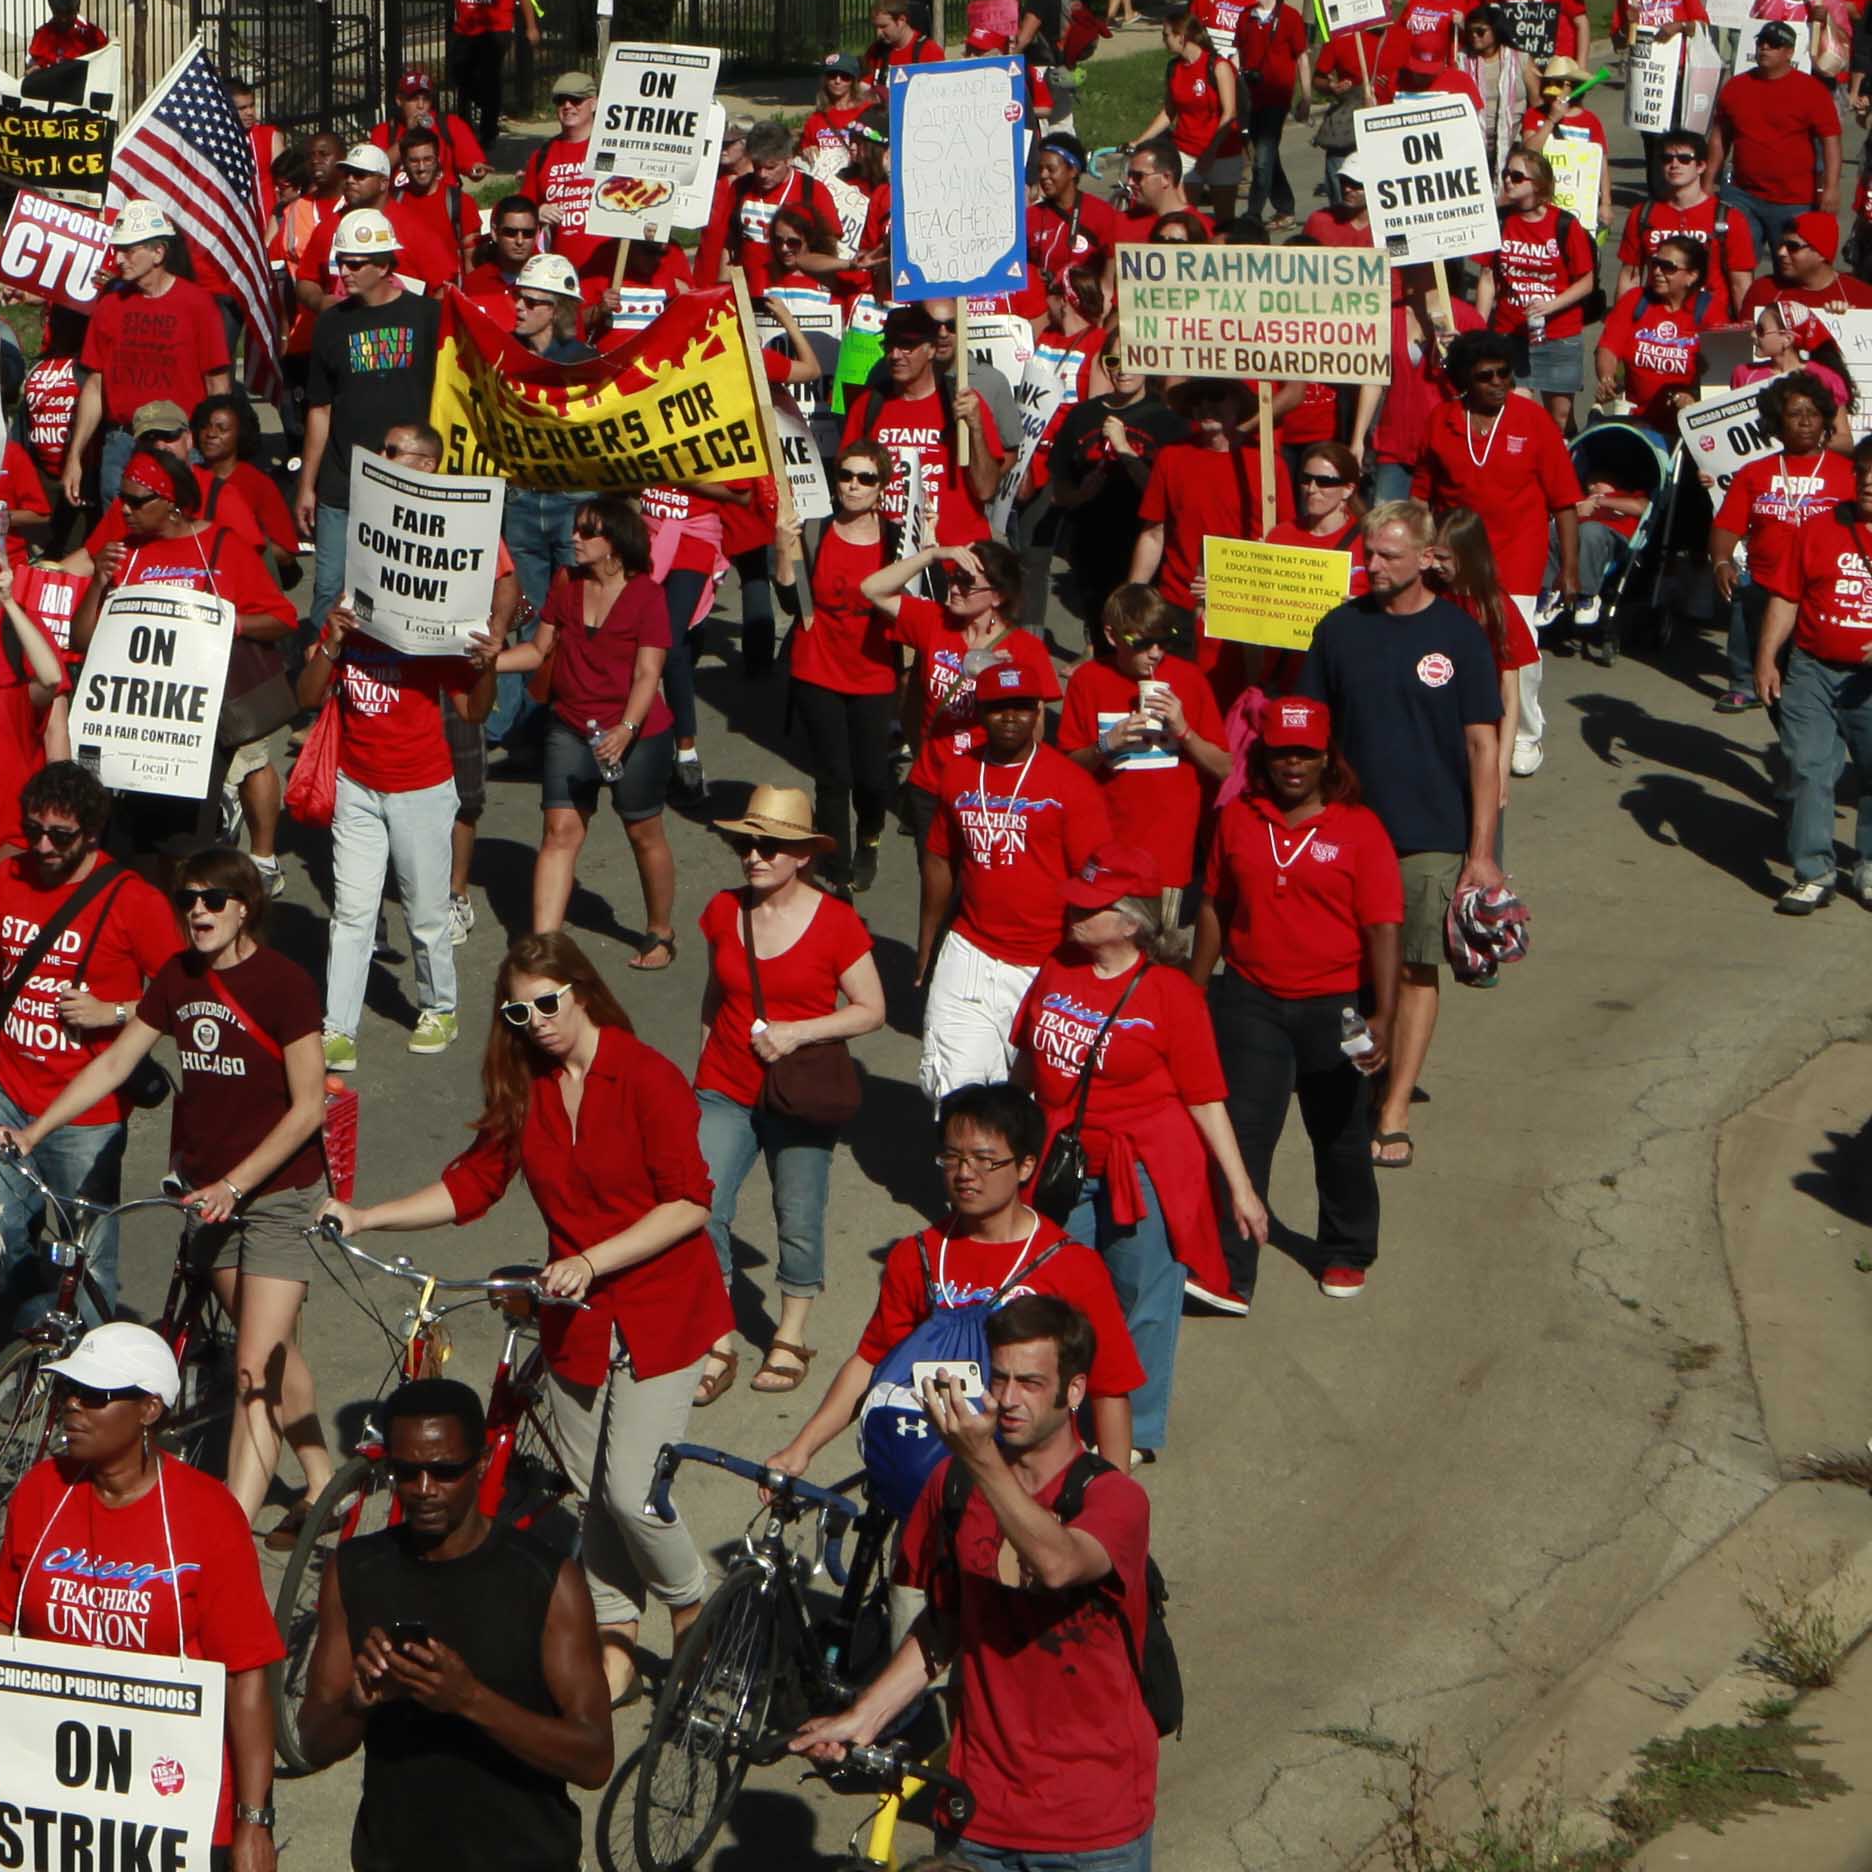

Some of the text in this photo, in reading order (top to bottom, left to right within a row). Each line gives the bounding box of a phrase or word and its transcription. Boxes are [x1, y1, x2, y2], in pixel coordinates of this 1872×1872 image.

[639, 71, 676, 98] ON
[1643, 87, 1663, 99] are
[605, 105, 697, 136] STRIKE
[1645, 100, 1662, 112] for
[601, 138, 693, 155] FOR BETTER SCHOOLS
[913, 123, 996, 162] SAY
[1402, 132, 1443, 165] ON
[1377, 166, 1481, 211] STRIKE
[19, 200, 114, 241] SUPPORTS
[1384, 216, 1403, 228] FOR
[1413, 211, 1432, 224] FAIR
[1434, 204, 1485, 222] CONTRACT
[1, 222, 106, 302] CTU
[1120, 251, 1385, 286] NO RAHMUNISM
[1133, 288, 1380, 315] KEEP TAX DOLLARS
[1134, 315, 1378, 346] IN THE CLASSROOM
[1127, 345, 1391, 377] NOT THE BOARDROOM
[1634, 352, 1686, 375] UNION
[1638, 342, 1688, 359] TEACHERS
[659, 383, 716, 435] FOR
[392, 505, 445, 538] FAIR
[358, 522, 483, 572] CONTRACT
[1231, 550, 1328, 568] YOU THINK THAT PUBLIC
[380, 566, 448, 603] NOW!
[1210, 574, 1248, 585] COUNTRY
[1259, 580, 1274, 588] NOT
[1277, 583, 1306, 592] UNDER
[1309, 588, 1340, 596] ATTACK
[1226, 563, 1324, 581] EDUCATION ACROSS THE
[111, 599, 173, 615] CHICAGO PUBLIC
[1211, 603, 1266, 616] HOODWINKED
[1268, 611, 1285, 620] AND
[1252, 595, 1331, 611] BEEN BAMBOOZLED
[404, 620, 447, 637] Local
[128, 627, 175, 667] ON
[85, 672, 208, 723] STRIKE
[82, 722, 103, 737] FOR
[114, 726, 139, 742] FAIR
[141, 729, 201, 748] CONTRACT
[131, 759, 170, 775] Local
[42, 1547, 201, 1590] Chicago
[49, 1577, 151, 1615] TEACHERS
[46, 1603, 147, 1649] UNION
[65, 1676, 120, 1702] PUBLIC
[123, 1683, 197, 1711] SCHOOLS
[55, 1719, 132, 1795] ON
